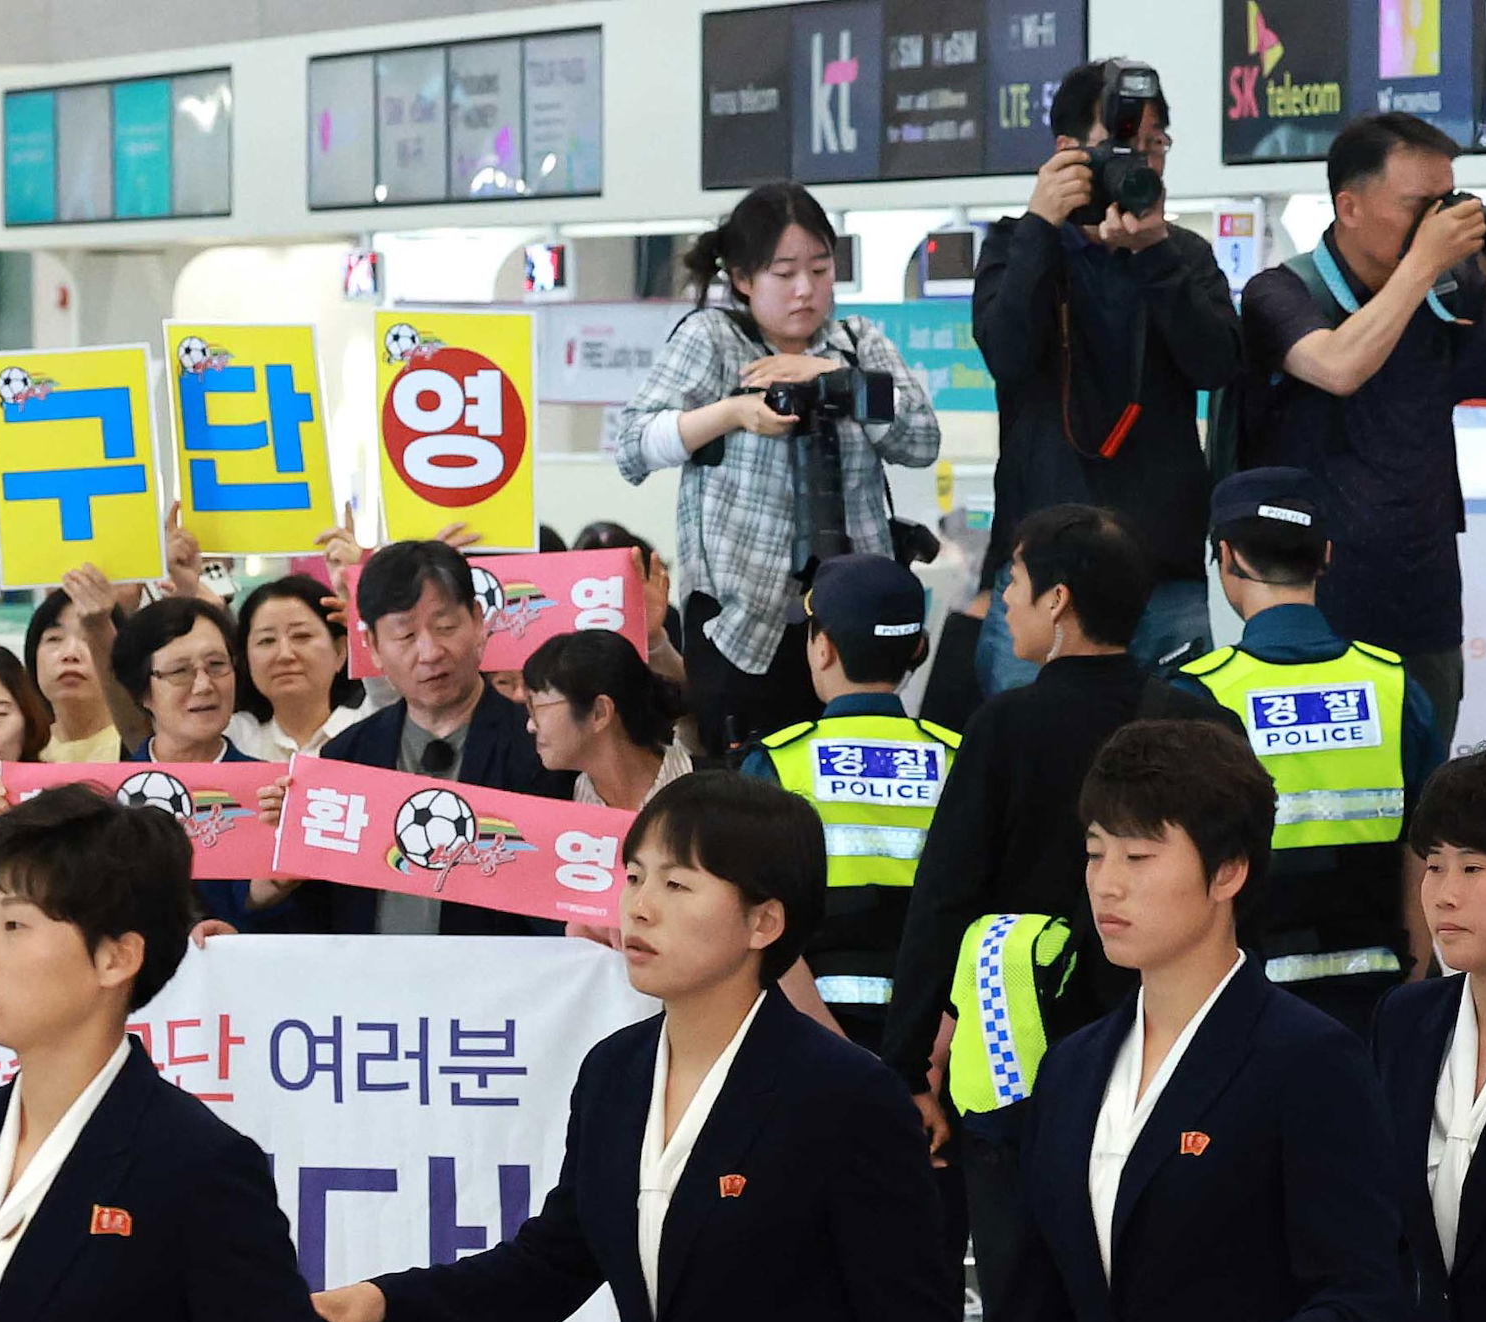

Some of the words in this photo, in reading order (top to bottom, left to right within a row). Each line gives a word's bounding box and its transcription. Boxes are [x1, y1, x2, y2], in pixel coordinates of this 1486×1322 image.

[811, 29, 859, 154] kt
[1228, 65, 1260, 120] SK
[1266, 71, 1341, 118] telecom
[2, 386, 147, 542] 구
[178, 363, 314, 512] 단
[392, 368, 505, 489] 영
[569, 575, 626, 631] 영
[1266, 727, 1364, 748] POLICE
[301, 787, 369, 854] 환
[554, 830, 619, 892] 영
[831, 780, 931, 800] POLICE
[270, 1014, 528, 1107] 여러분
